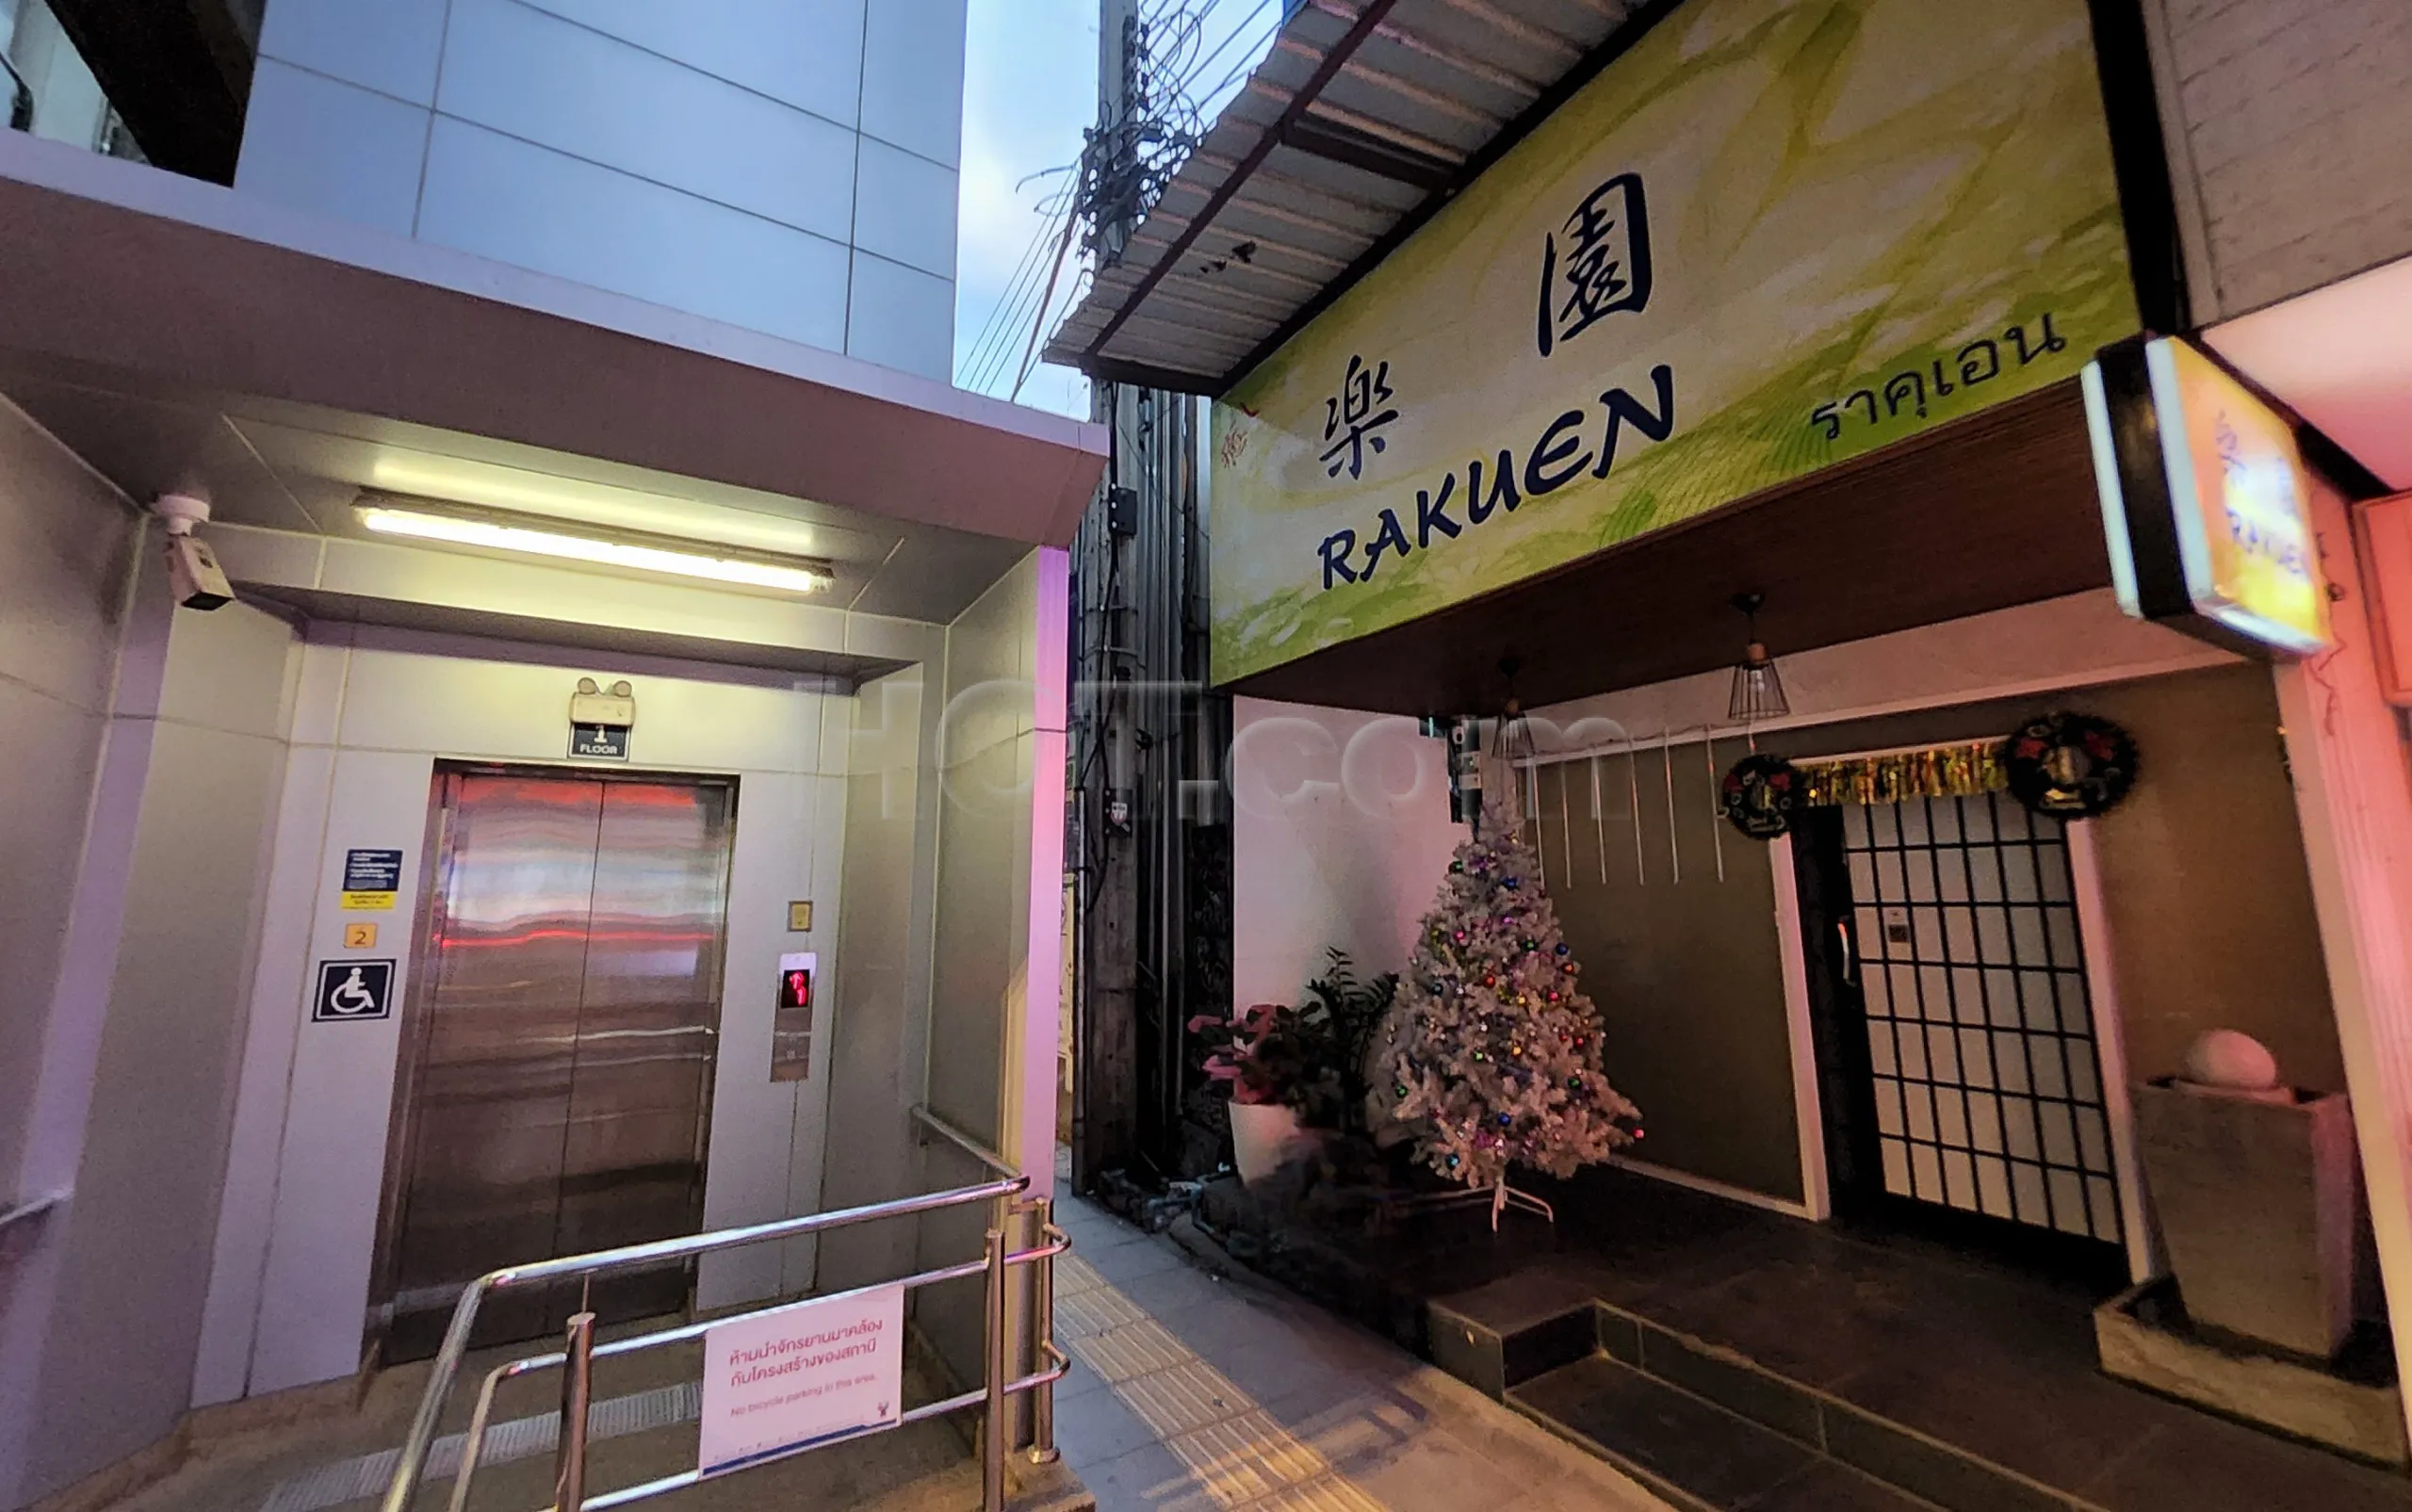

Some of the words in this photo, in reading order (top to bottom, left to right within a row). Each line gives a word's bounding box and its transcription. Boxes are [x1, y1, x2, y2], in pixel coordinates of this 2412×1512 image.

[1811, 313, 2067, 440] ราคุเอน
[1317, 364, 1673, 591] RAKUEN
[594, 724, 608, 743] 1
[579, 743, 618, 755] FLOOR
[353, 930, 367, 945] 2
